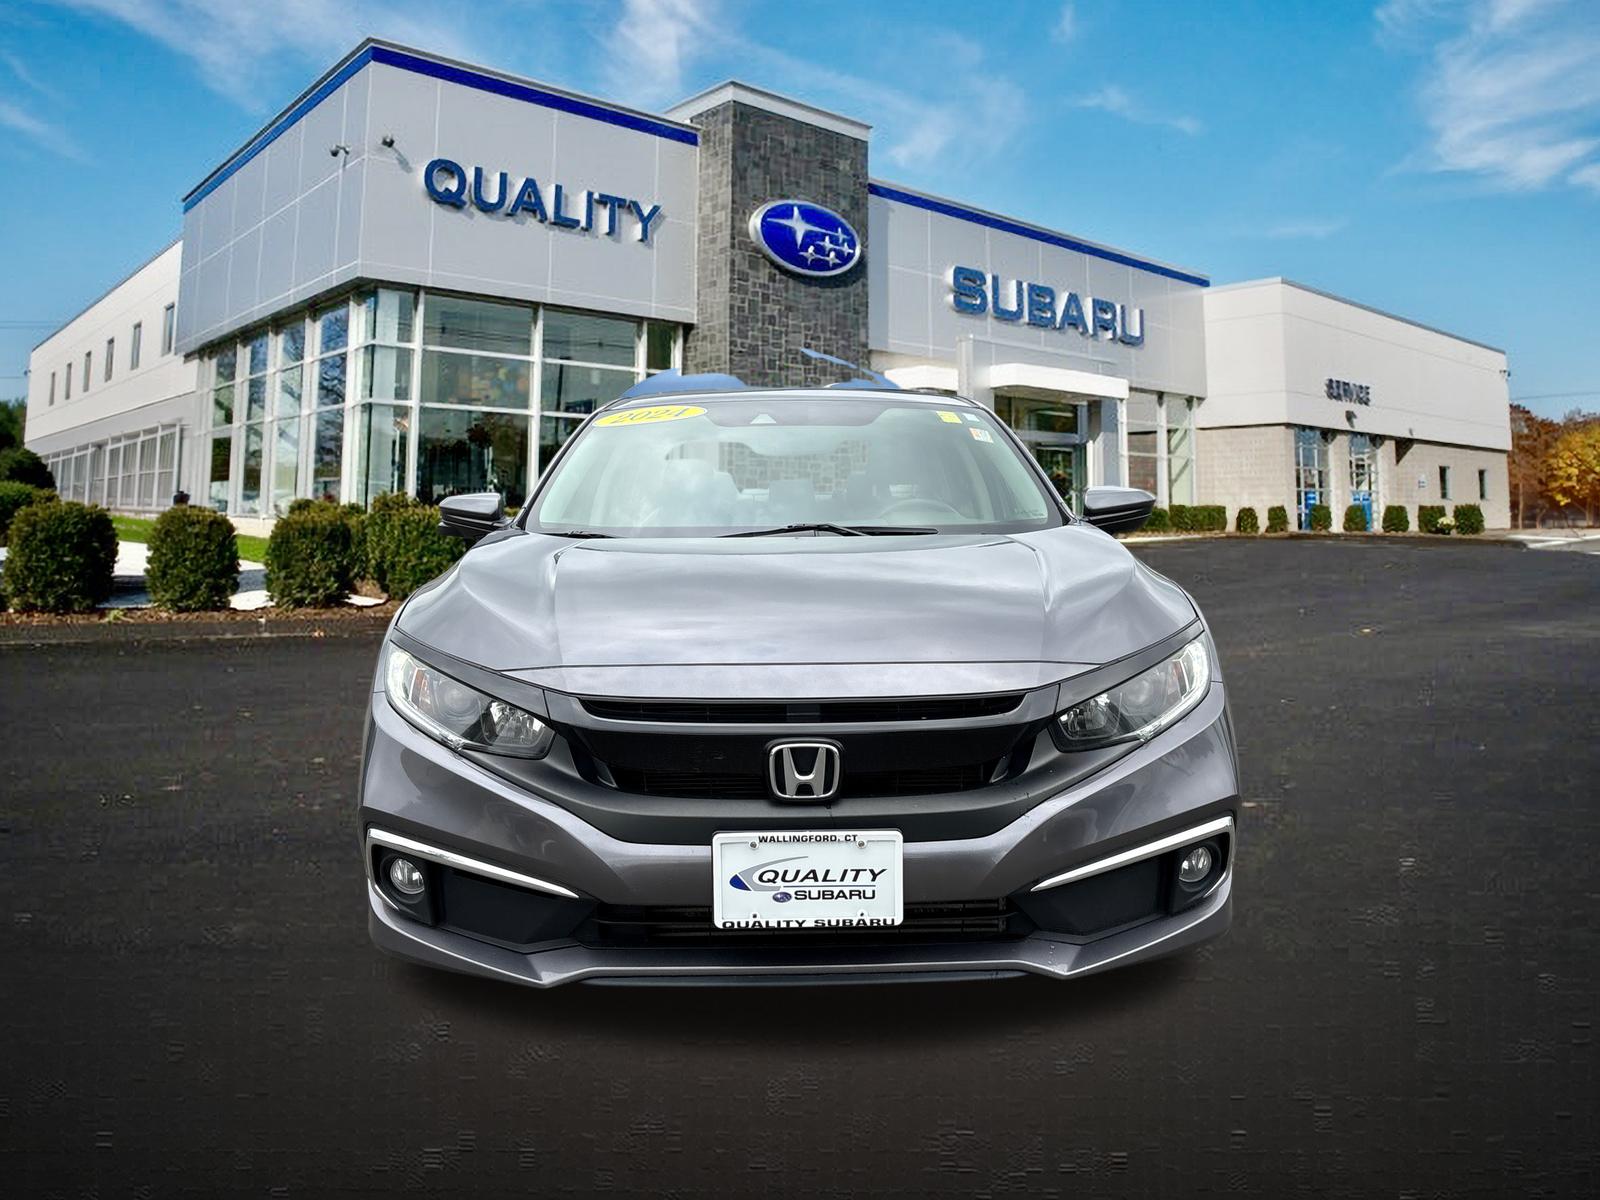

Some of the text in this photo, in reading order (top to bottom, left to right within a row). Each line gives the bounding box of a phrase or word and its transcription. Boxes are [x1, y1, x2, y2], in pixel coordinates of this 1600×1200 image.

[423, 158, 662, 244] QUALITY
[950, 264, 1146, 348] SUBARU
[1325, 378, 1371, 406] SERVICE
[844, 834, 858, 842] CT
[758, 868, 888, 884] QUALITY
[794, 889, 876, 901] SUBARU
[722, 918, 896, 929] QUALITY SUBARU
